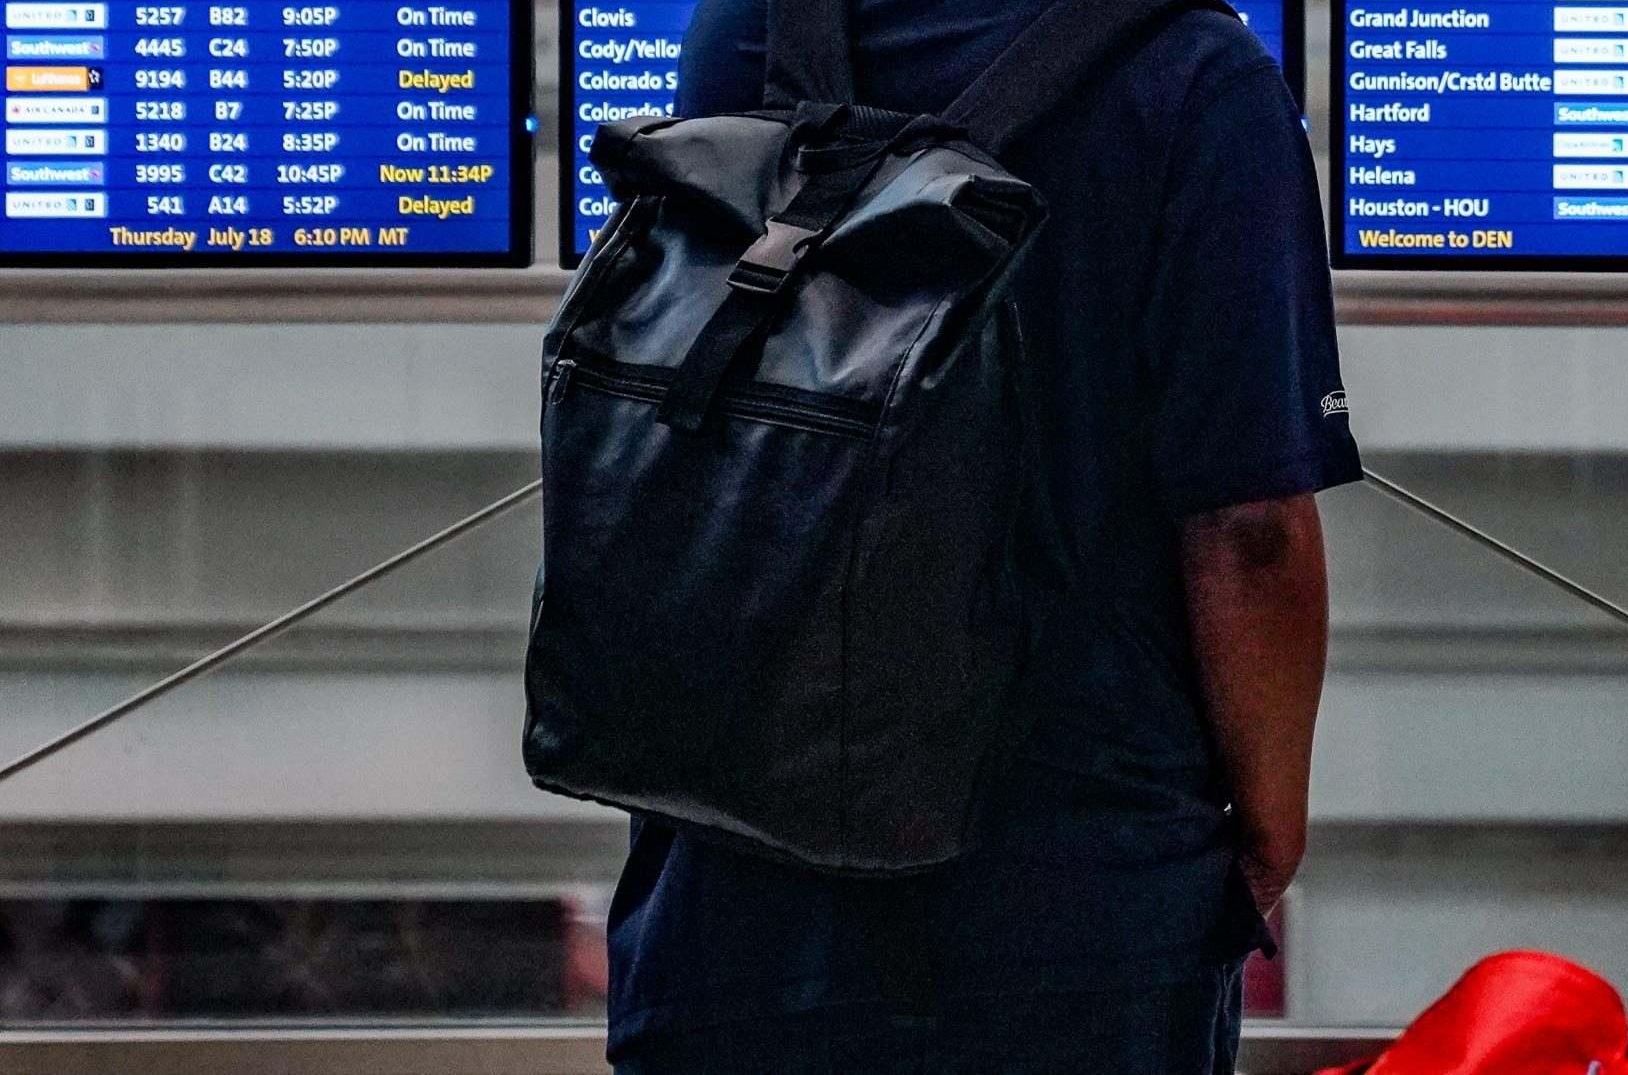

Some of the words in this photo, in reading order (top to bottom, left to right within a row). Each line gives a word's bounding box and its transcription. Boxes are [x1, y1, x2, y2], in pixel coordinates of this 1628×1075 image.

[1351, 103, 1429, 121] Hartford
[11, 167, 92, 184] Southwest
[136, 165, 182, 182] 3995
[209, 165, 245, 182] C42
[278, 165, 342, 182] 10:45P
[381, 165, 424, 182] Now
[428, 165, 493, 182] 11:34P
[110, 227, 195, 250] Thursday
[208, 227, 244, 250] July
[249, 229, 272, 245] 18
[295, 229, 336, 245] 6:10
[341, 228, 369, 245] PM
[379, 228, 408, 245] MT
[1359, 229, 1445, 247] Welcome
[1448, 231, 1469, 247] to
[1473, 231, 1512, 247] DEN
